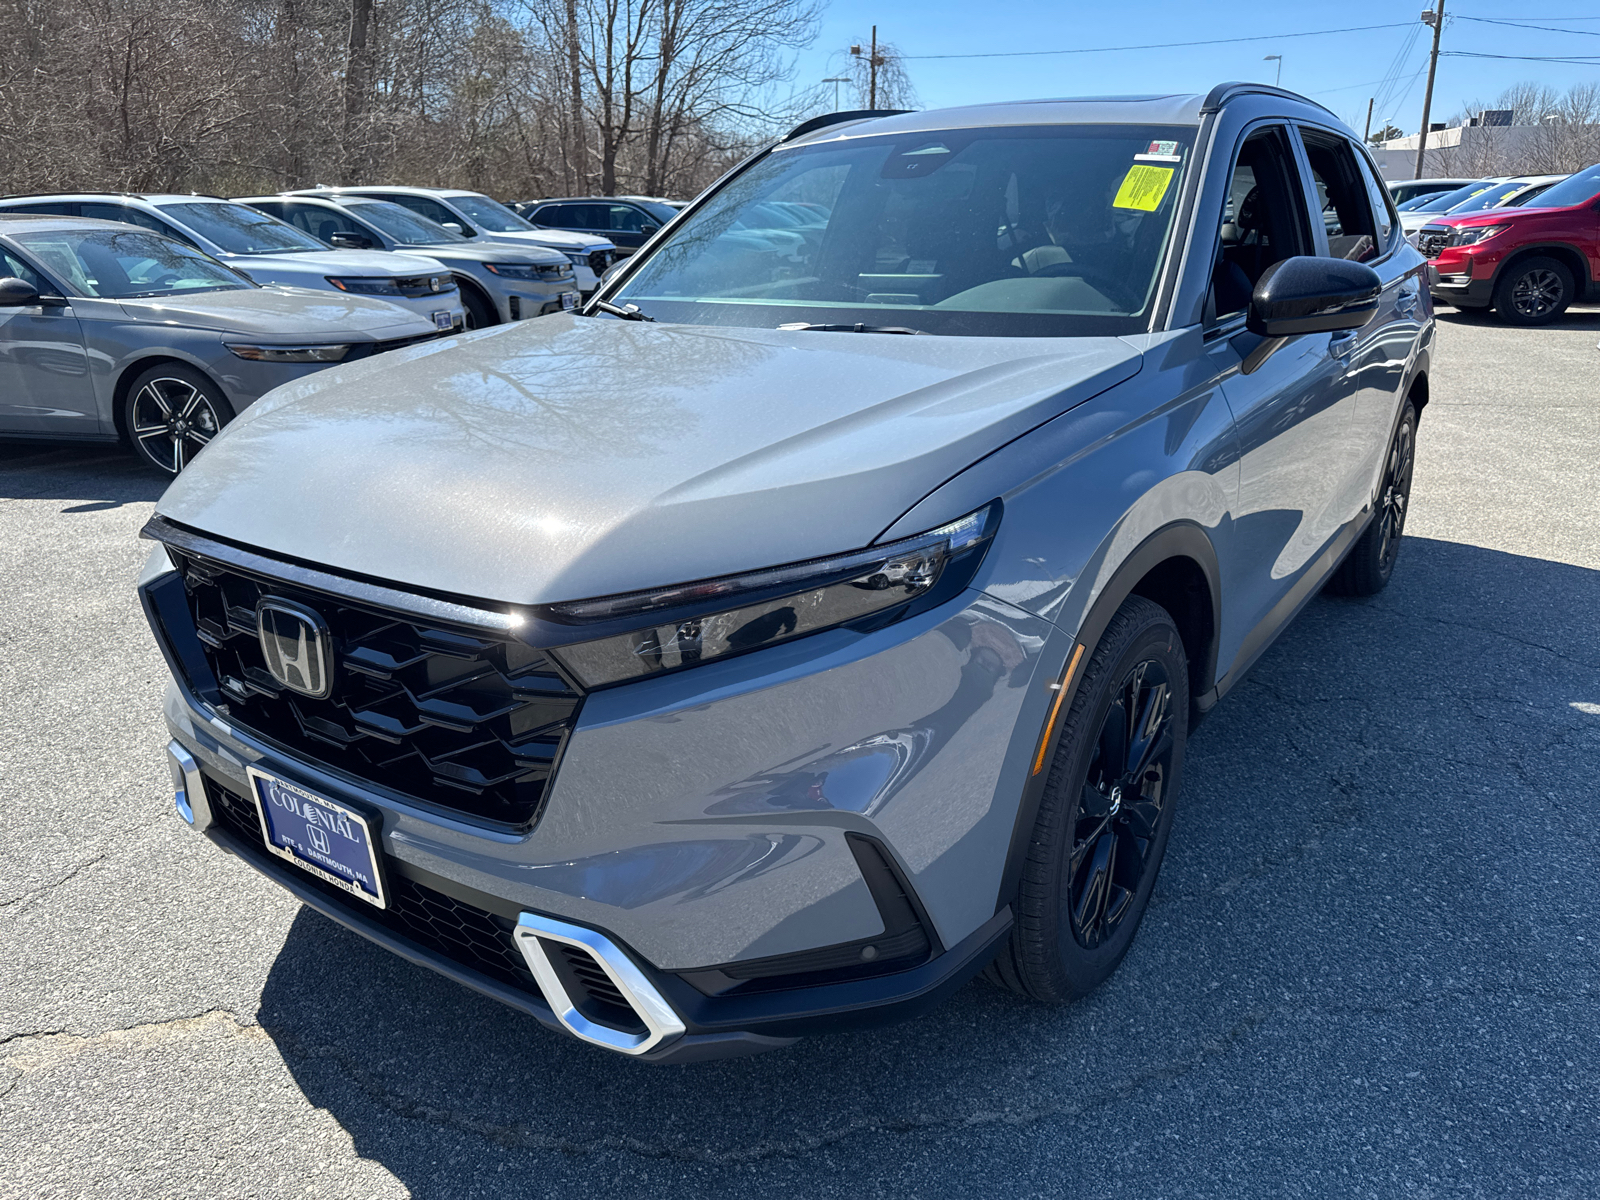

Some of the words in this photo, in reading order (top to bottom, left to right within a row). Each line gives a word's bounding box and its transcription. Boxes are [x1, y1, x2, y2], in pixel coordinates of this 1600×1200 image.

[269, 787, 360, 844] COLONIAL
[323, 800, 336, 810] MA
[281, 834, 297, 848] RTE.
[307, 847, 355, 878] DARTMOUTH,
[355, 871, 369, 884] MA
[293, 857, 328, 880] COLONIAL
[328, 876, 355, 894] HONDA
